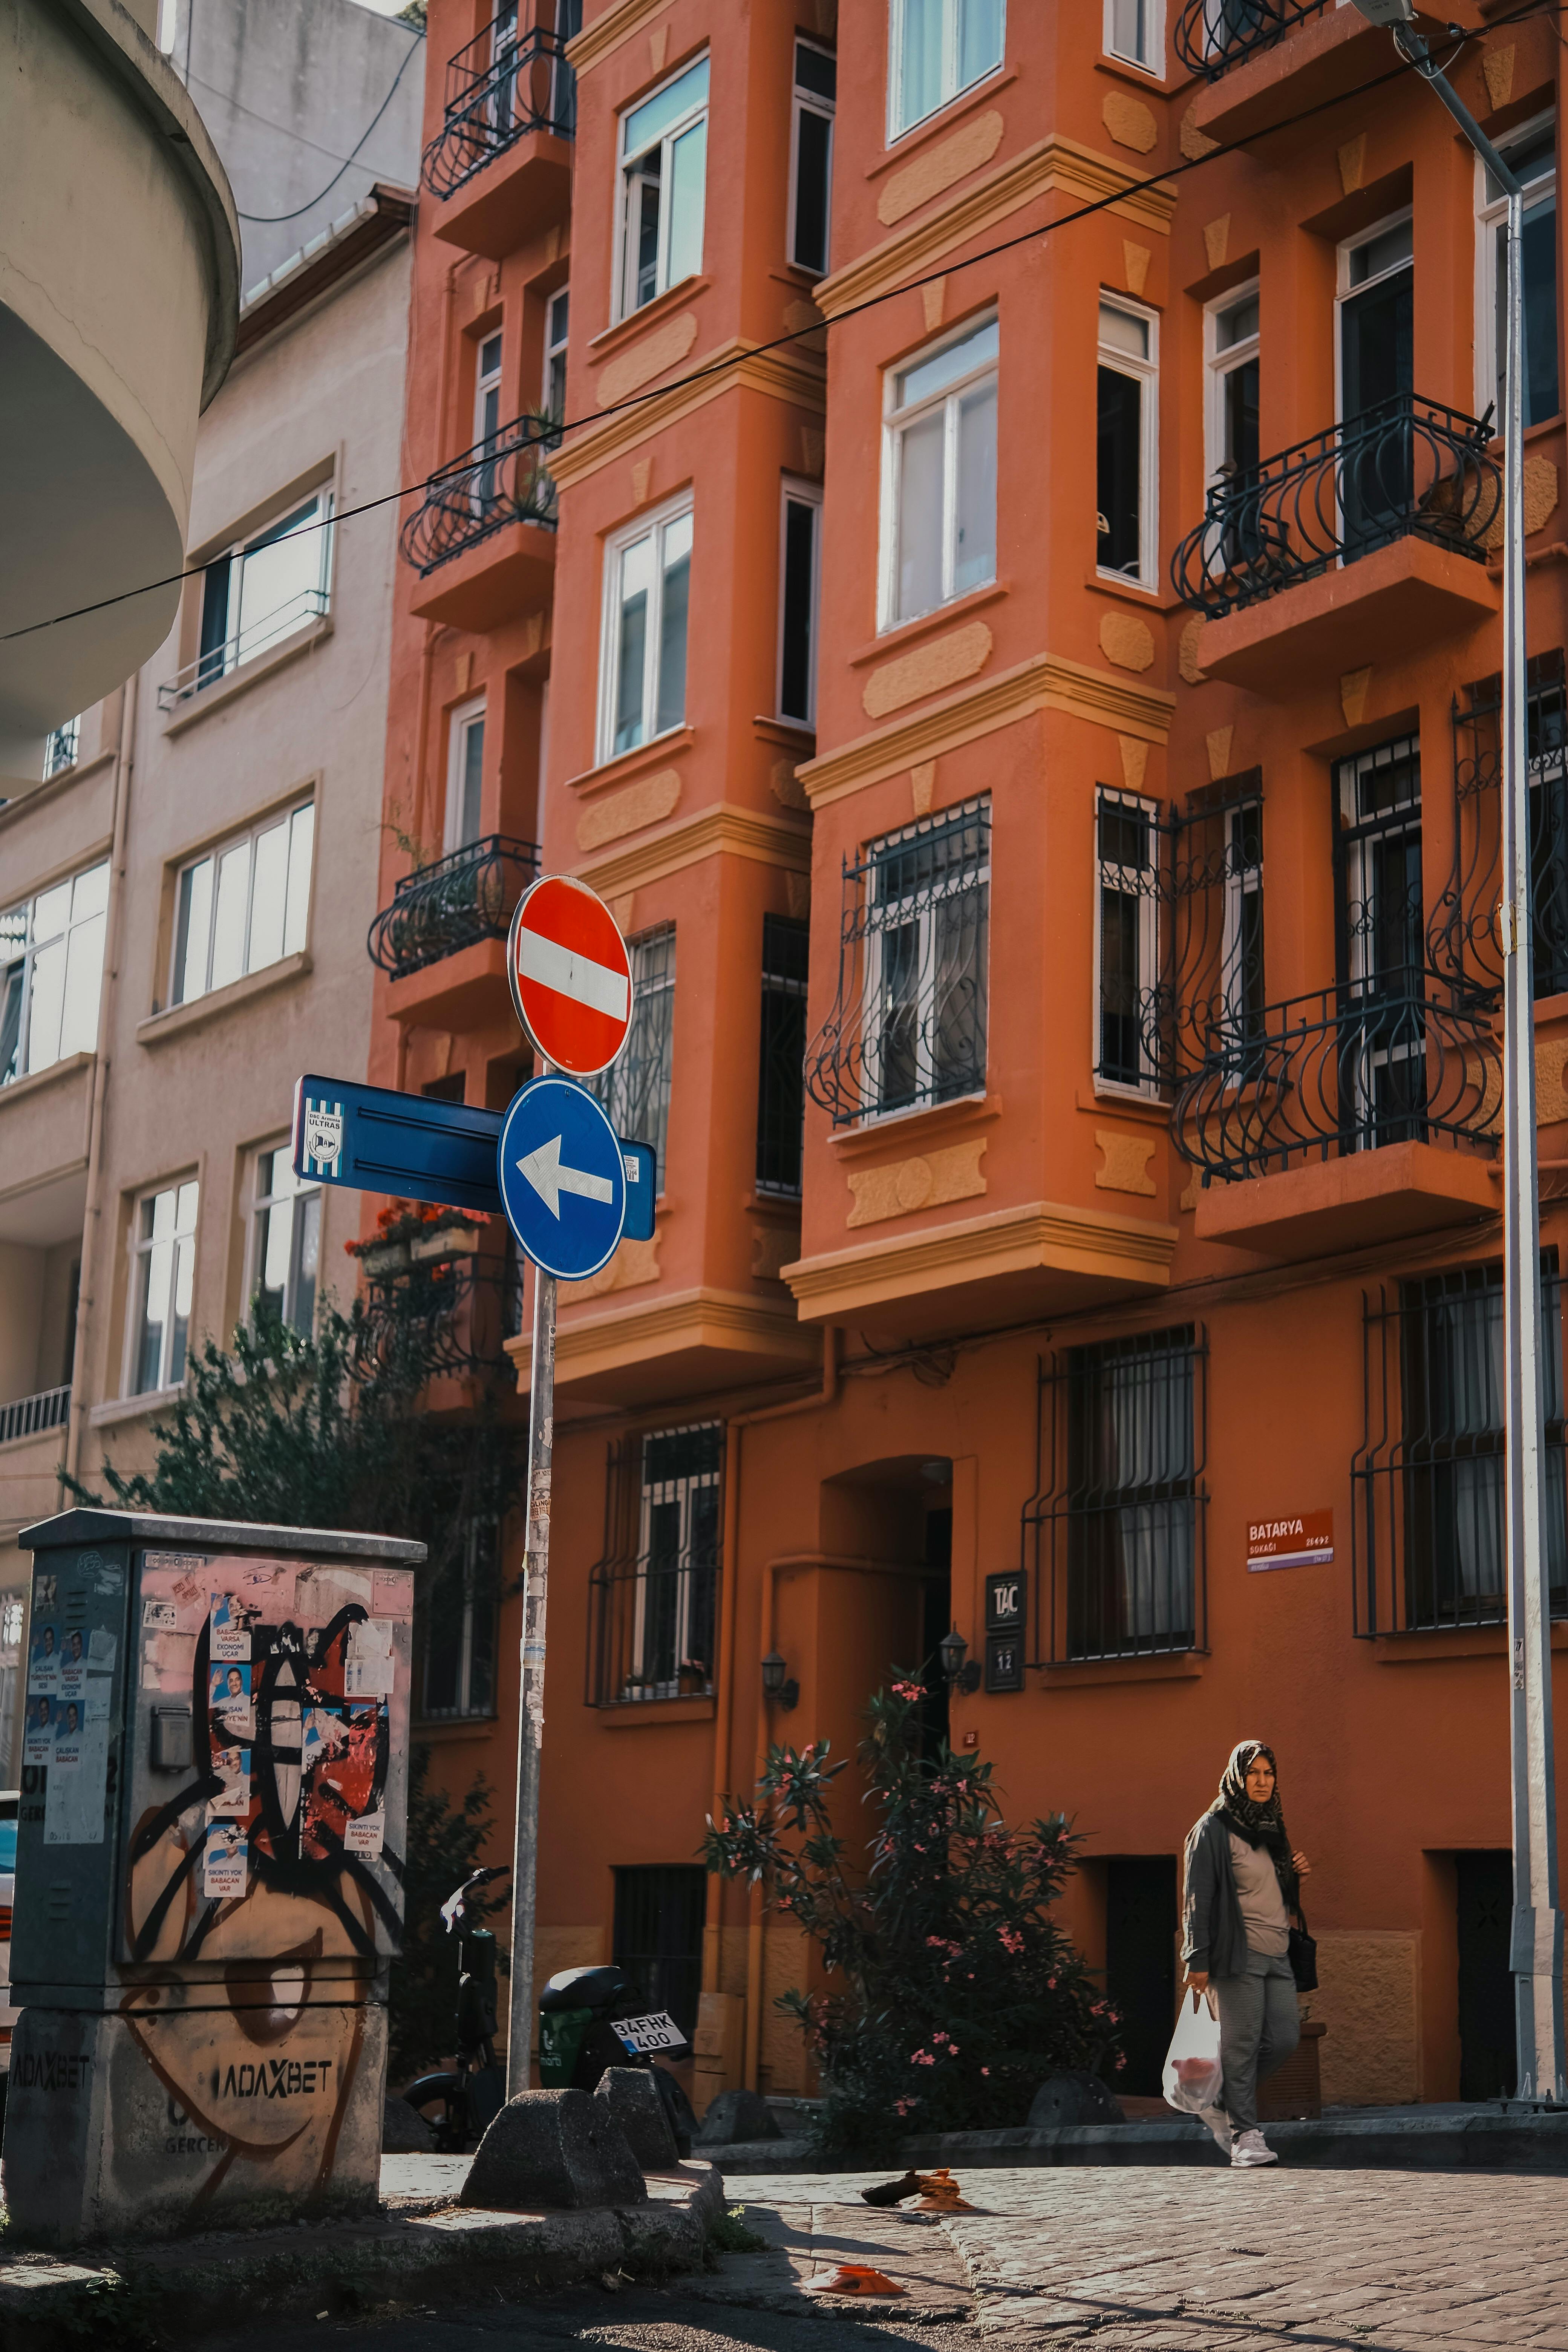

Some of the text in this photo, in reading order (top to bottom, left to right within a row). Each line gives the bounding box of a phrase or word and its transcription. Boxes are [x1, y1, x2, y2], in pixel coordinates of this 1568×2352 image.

[309, 1118, 340, 1129] ULTRAS
[1249, 1519, 1303, 1541] BATARYA
[1250, 1542, 1276, 1555] SOKAĞI
[997, 1654, 1012, 1670] 12
[636, 2032, 671, 2049] 400
[13, 2050, 90, 2091] ADAXBET
[224, 2059, 332, 2099] ADAXBET
